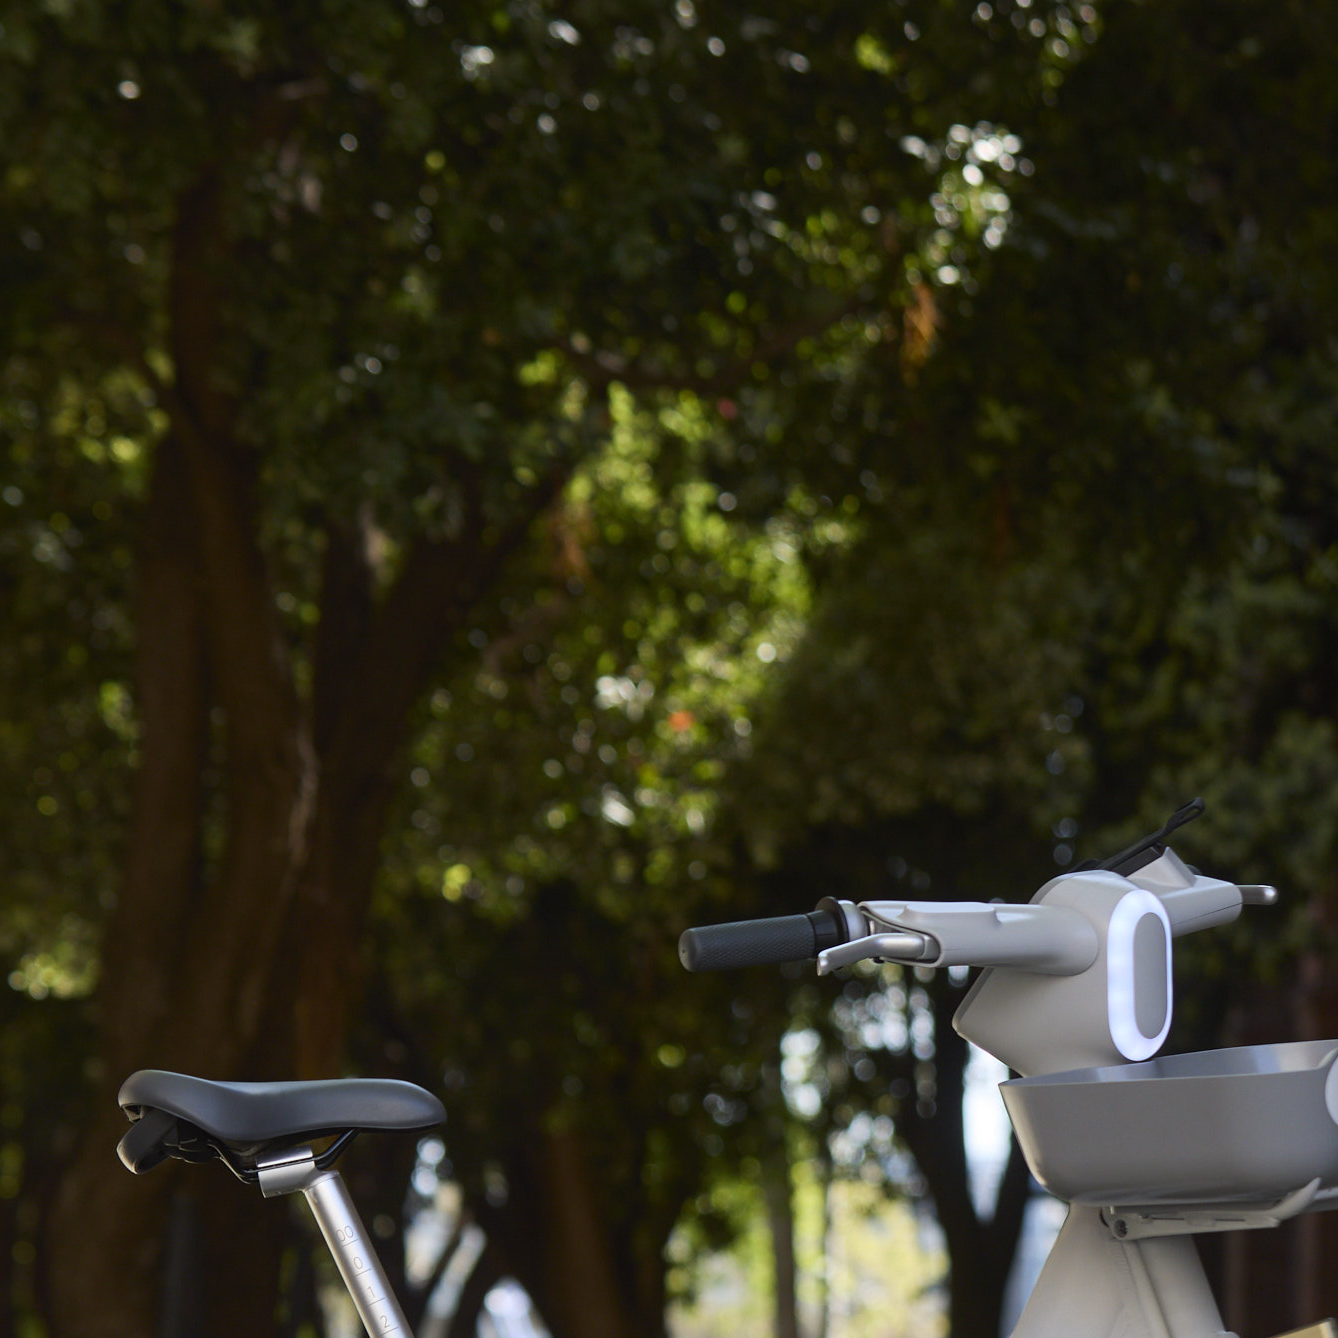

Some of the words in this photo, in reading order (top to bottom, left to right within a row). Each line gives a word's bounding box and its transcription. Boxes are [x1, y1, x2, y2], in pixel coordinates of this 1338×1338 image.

[336, 1225, 354, 1242] 00
[353, 1256, 364, 1270] 0
[367, 1286, 375, 1299] 1
[380, 1315, 391, 1329] 2
